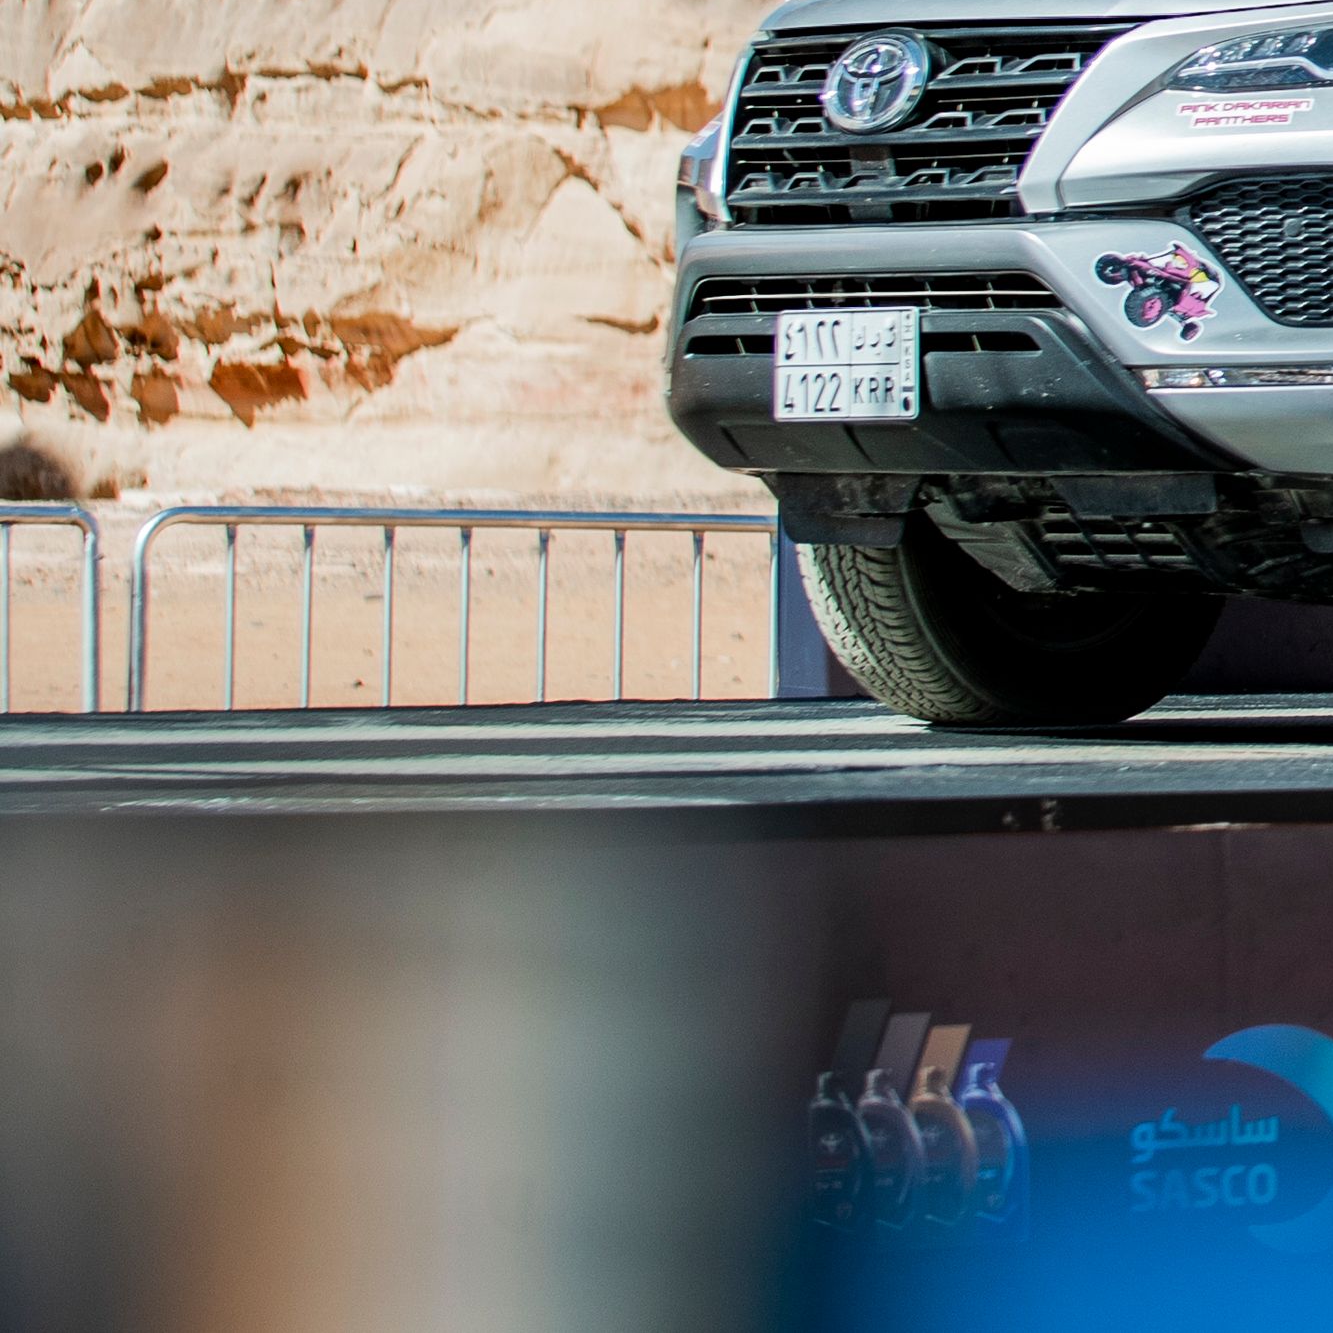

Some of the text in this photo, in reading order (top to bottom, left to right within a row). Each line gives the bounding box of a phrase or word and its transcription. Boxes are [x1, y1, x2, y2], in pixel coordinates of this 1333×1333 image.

[1193, 114, 1290, 127] PANTHERS
[783, 372, 897, 414] 4122 KRR
[1130, 1163, 1278, 1213] SASCO
